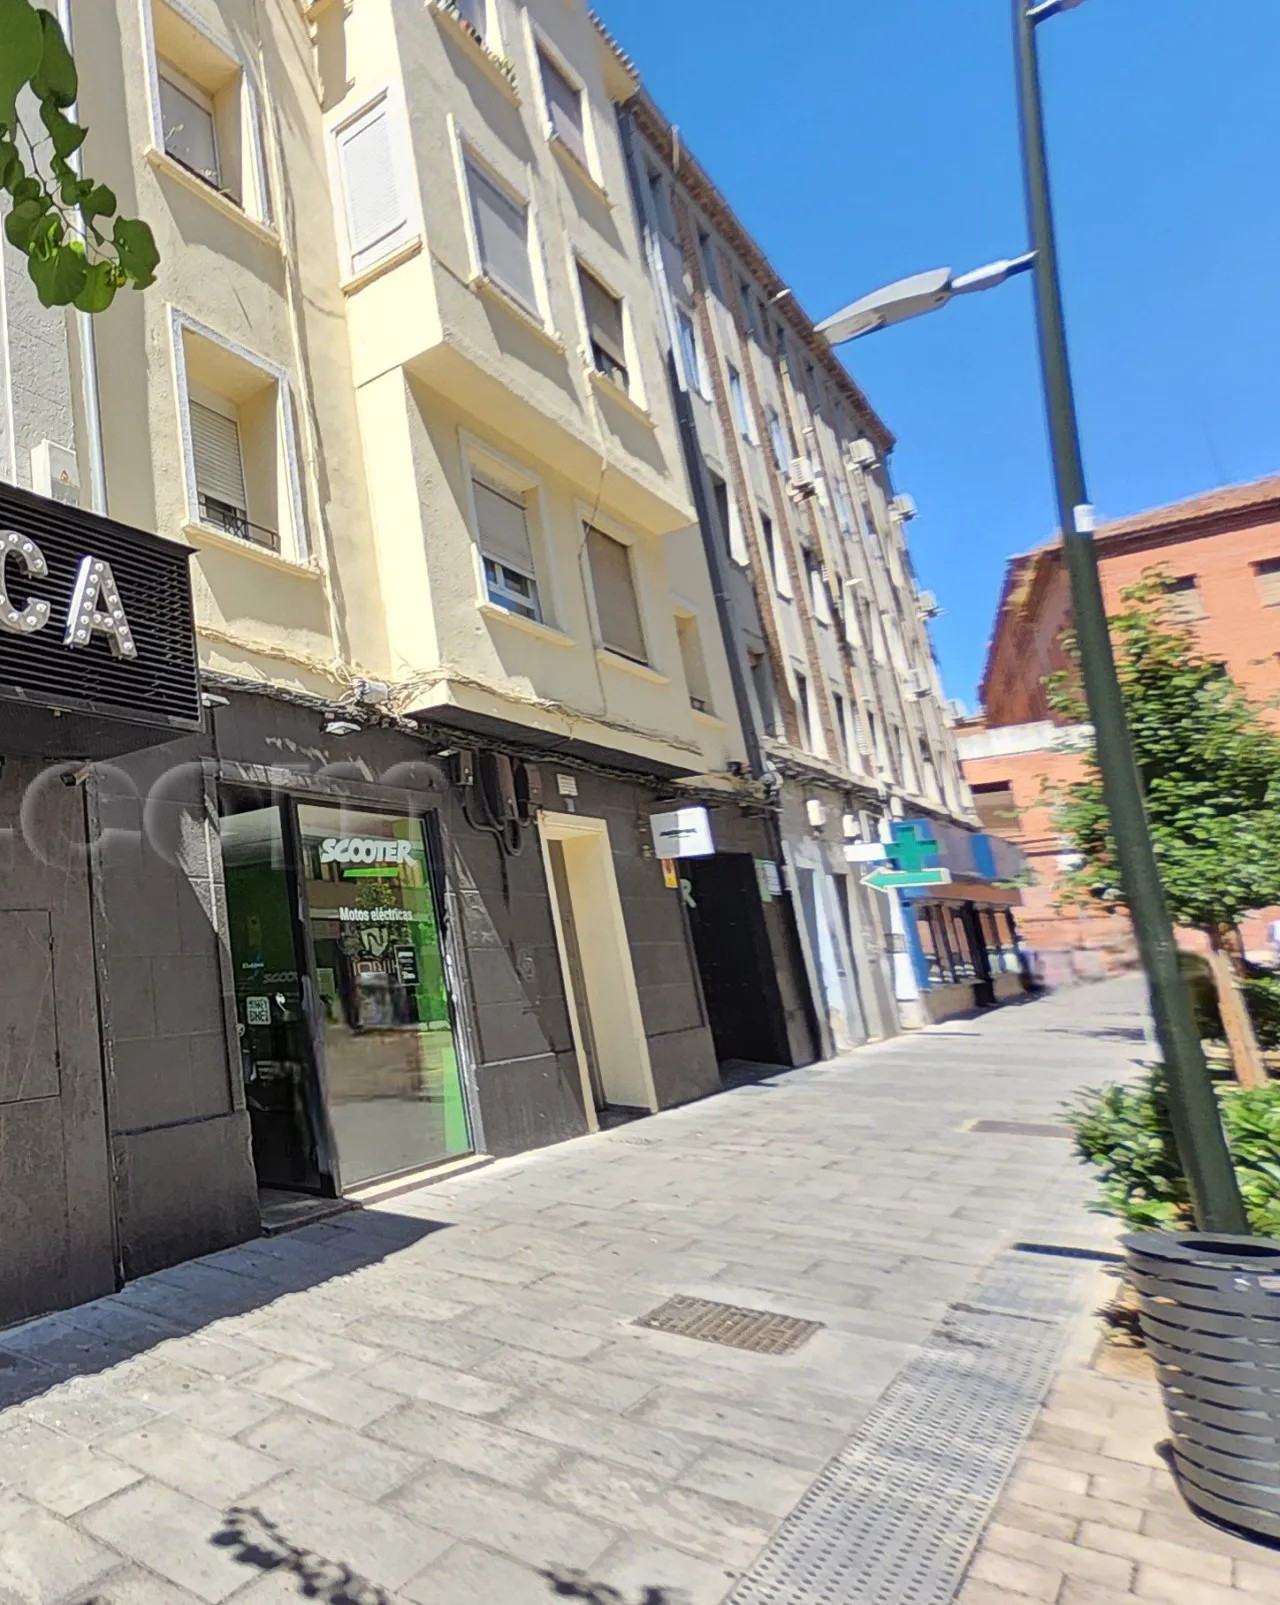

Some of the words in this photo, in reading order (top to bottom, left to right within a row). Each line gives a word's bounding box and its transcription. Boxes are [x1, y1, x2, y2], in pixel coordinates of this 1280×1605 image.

[321, 838, 417, 866] SCOOTER
[339, 906, 369, 921] Motos
[371, 906, 413, 921] eléctricas
